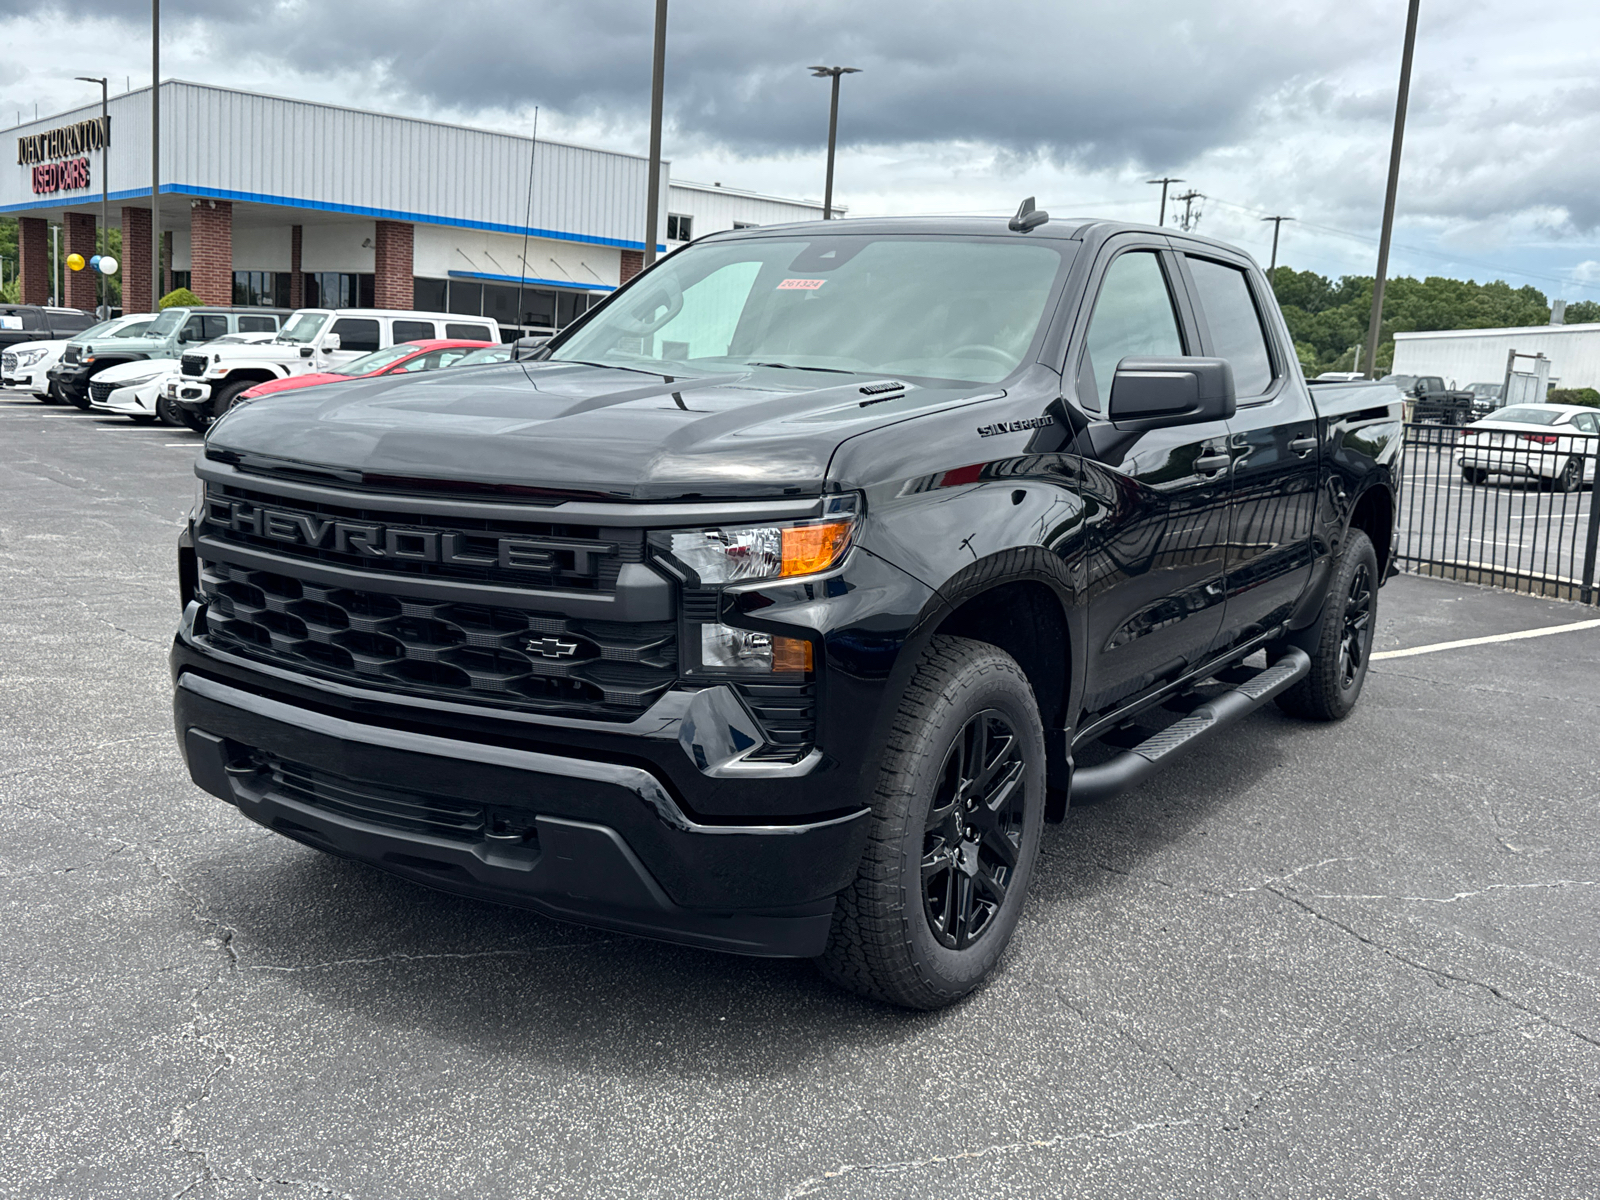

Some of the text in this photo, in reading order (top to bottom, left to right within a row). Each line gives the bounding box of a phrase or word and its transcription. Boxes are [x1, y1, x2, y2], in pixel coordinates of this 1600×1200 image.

[17, 134, 44, 165] JOHN
[32, 157, 90, 194] USED CARS
[780, 279, 821, 289] 261324
[977, 414, 1055, 438] SILVERADO
[203, 493, 619, 578] CHEVROLET
